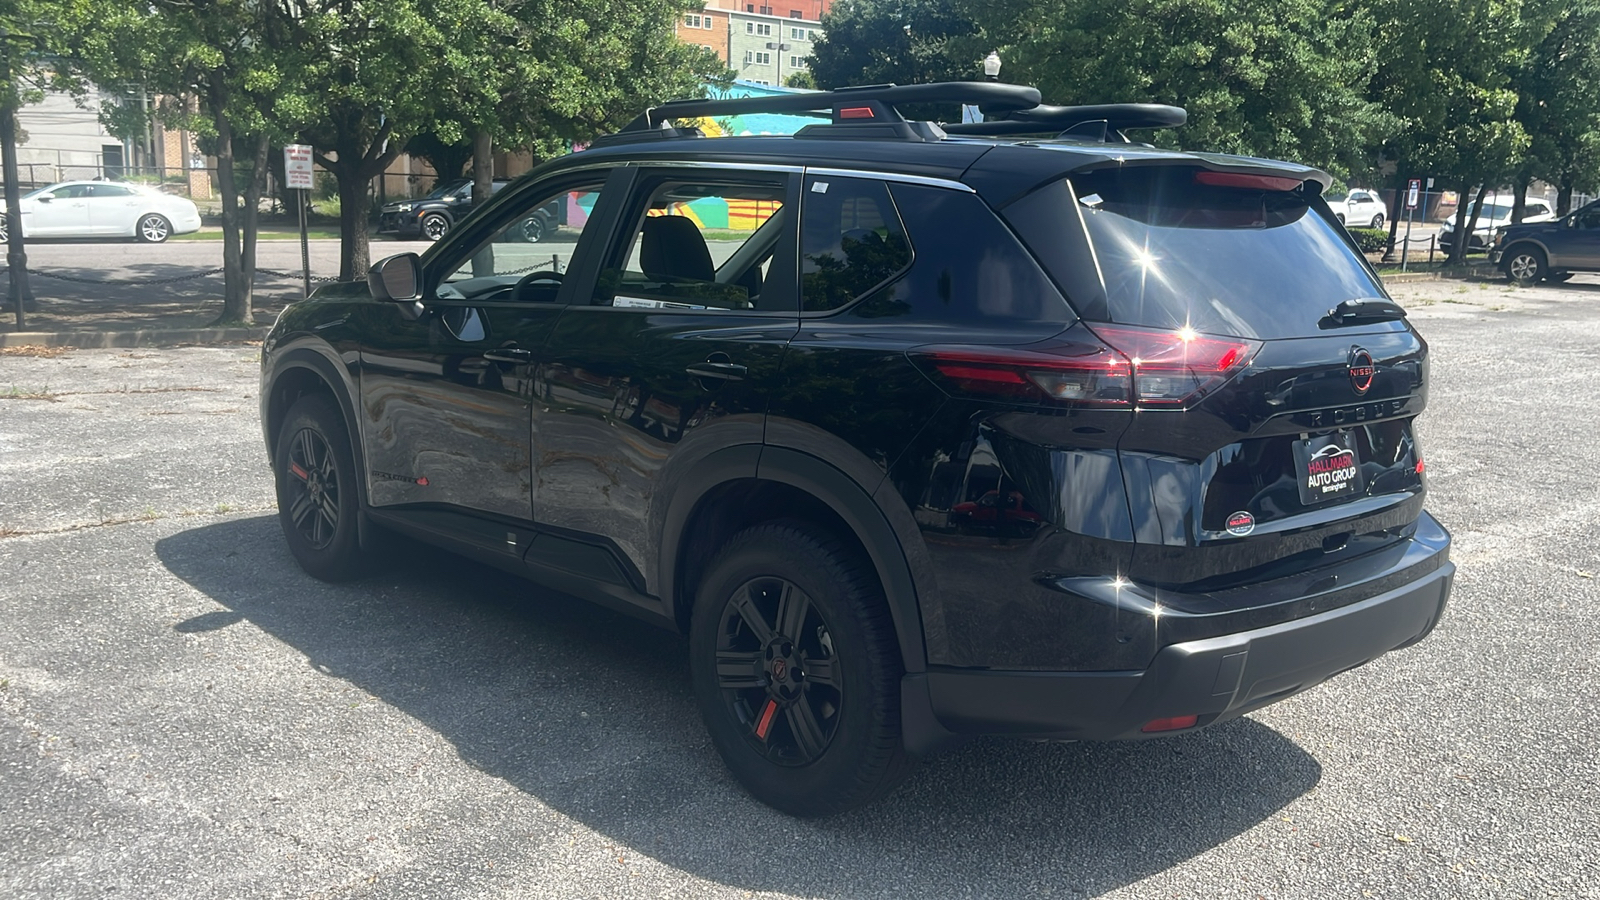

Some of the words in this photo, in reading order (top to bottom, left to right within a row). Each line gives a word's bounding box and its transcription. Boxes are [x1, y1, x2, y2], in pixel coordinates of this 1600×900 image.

[1310, 402, 1402, 427] ROGUE
[1308, 455, 1354, 475] HALLMARK
[1308, 472, 1331, 488] AUTO
[1332, 466, 1357, 483] GROUP
[1322, 481, 1347, 493] Birmingham
